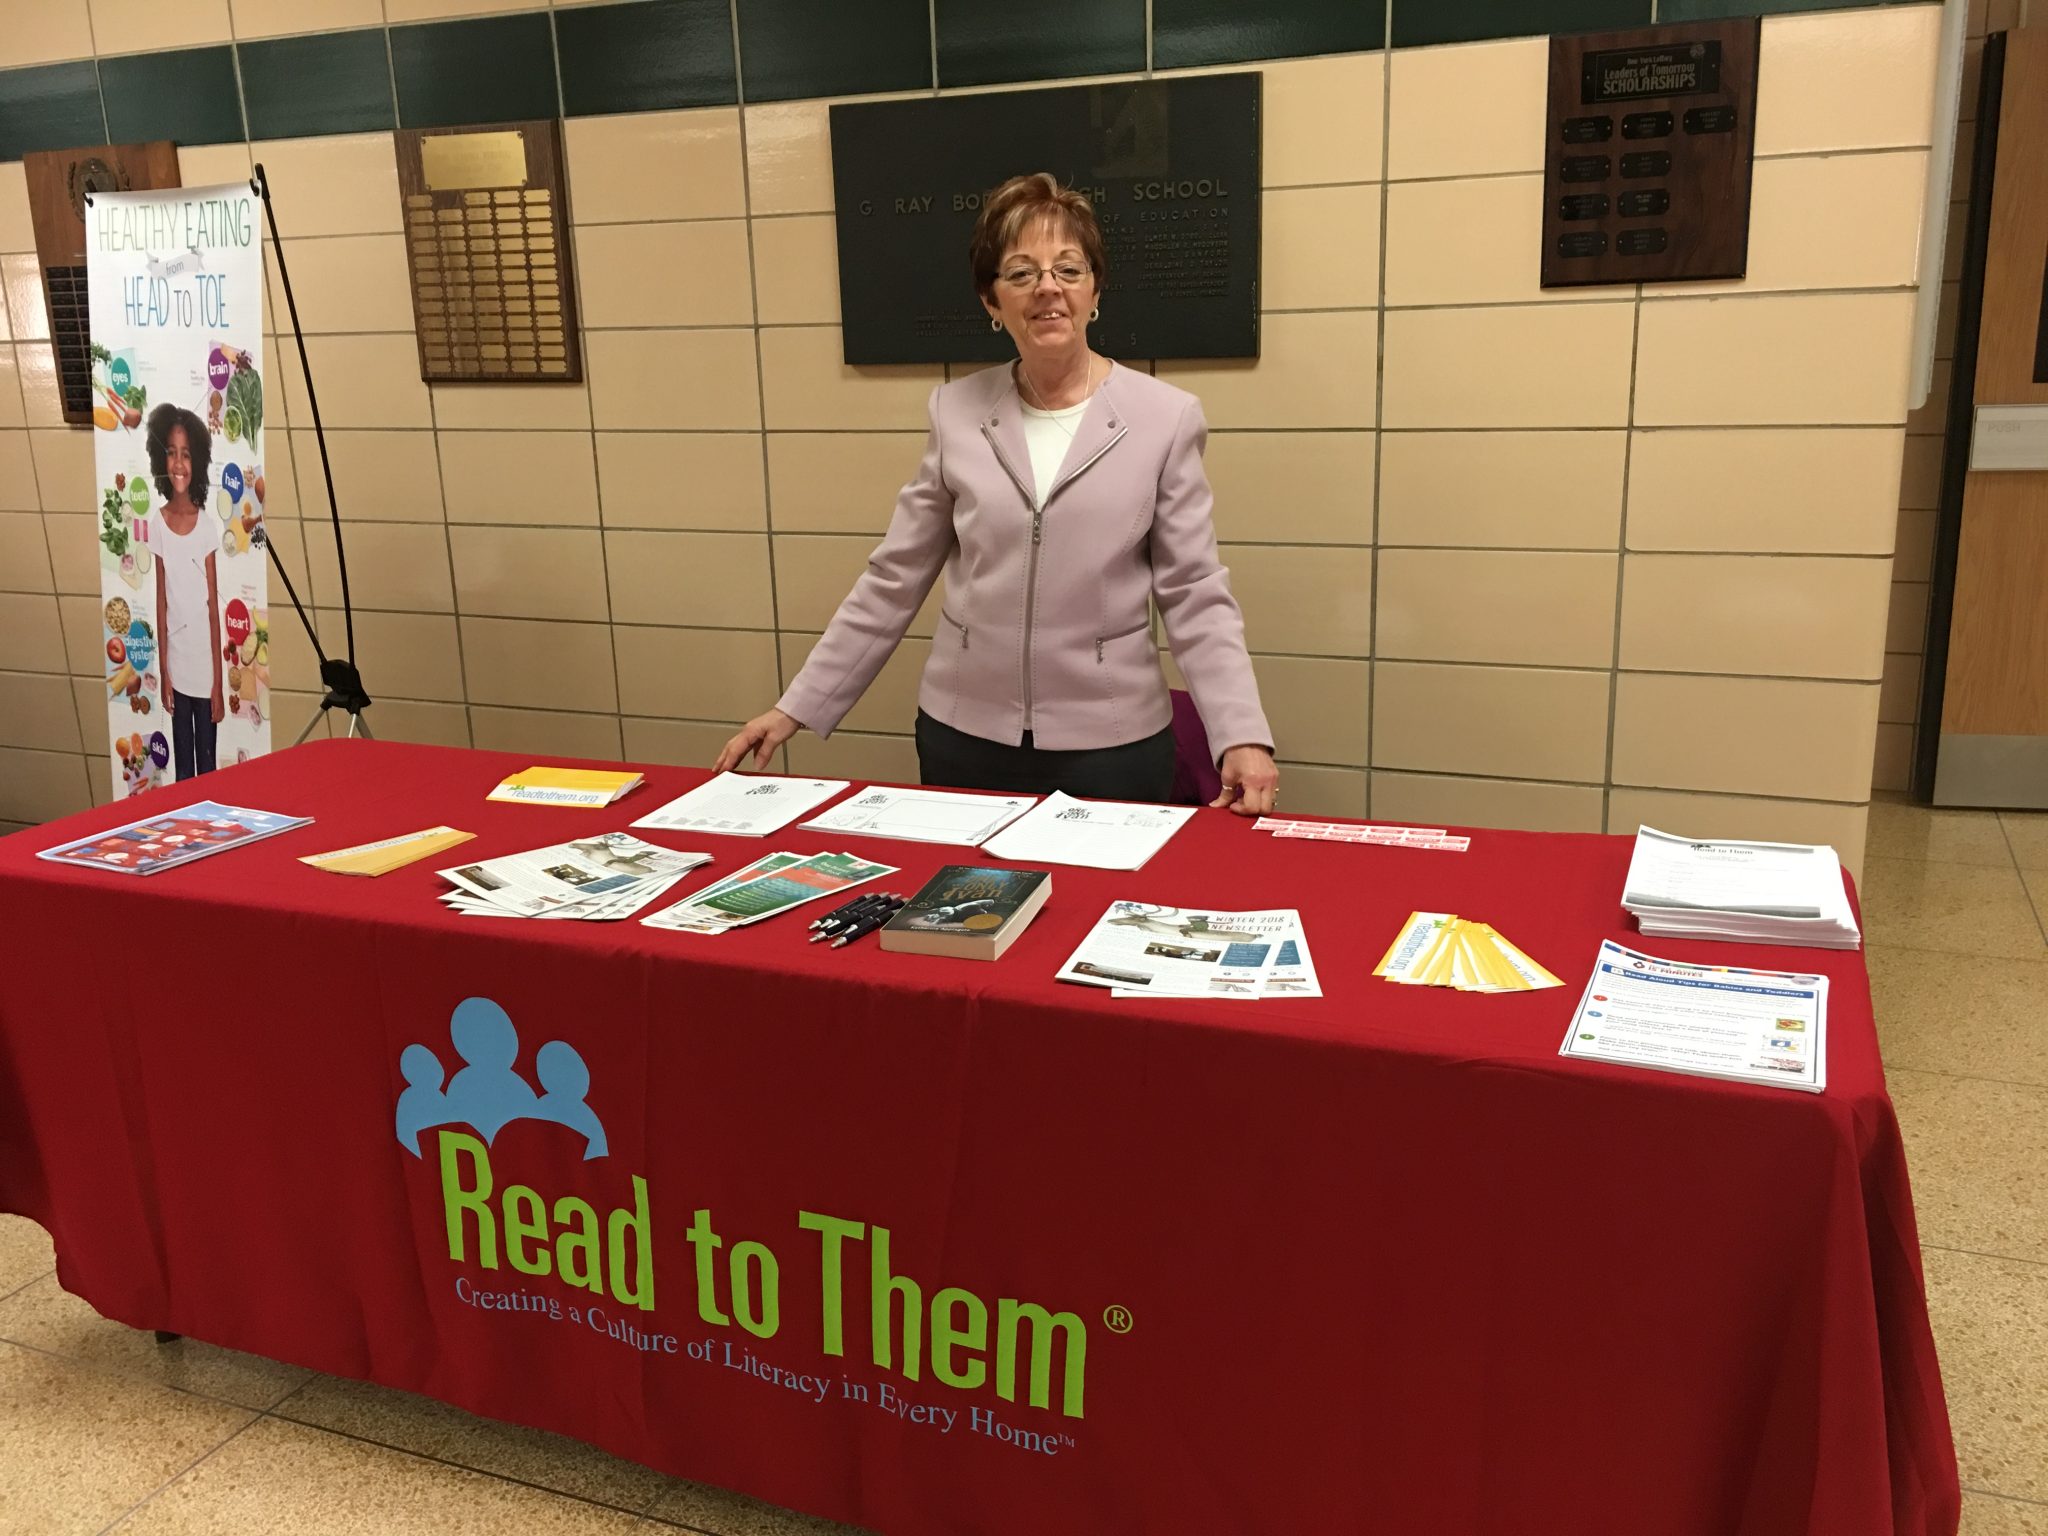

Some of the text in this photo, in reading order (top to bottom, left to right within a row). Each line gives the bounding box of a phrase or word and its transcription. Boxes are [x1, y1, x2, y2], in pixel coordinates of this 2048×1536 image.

[1604, 63, 1695, 80] Leaders of Tomorrow
[1603, 73, 1696, 94] SCHOLARSHIPS
[895, 196, 933, 214] RAY
[1133, 180, 1228, 201] SCHOOL
[1103, 208, 1229, 224] OF EDUCATION
[98, 199, 251, 251] HEALTHY EATING
[166, 261, 184, 275] from
[124, 274, 230, 328] HEAD TO TOE
[210, 362, 229, 376] brain
[112, 373, 129, 389] eyes
[1987, 422, 2021, 433] PUSH
[225, 472, 241, 490] hair
[131, 489, 149, 501] teeth
[227, 615, 249, 631] heart
[125, 636, 157, 652] digestive
[152, 740, 167, 756] skin
[511, 788, 599, 803] readtothem.org
[1215, 915, 1285, 924] WINTER 2018
[1211, 924, 1282, 932] NEWSLETTER
[1386, 923, 1432, 970] readtothem.org
[1625, 971, 1647, 980] Read
[1649, 975, 1675, 984] Aloud
[1677, 979, 1696, 987] Tips
[1713, 983, 1743, 992] Babies
[1764, 988, 1805, 997] Toddlers
[440, 1131, 654, 1310] Read
[687, 1211, 778, 1338] to
[800, 1212, 1086, 1417] Them
[454, 1277, 561, 1321] Creating
[568, 1305, 582, 1324] a
[587, 1307, 680, 1354] Culture
[687, 1338, 720, 1363] of
[723, 1342, 832, 1403] Literacy
[842, 1373, 869, 1402] in
[879, 1381, 959, 1434] Every
